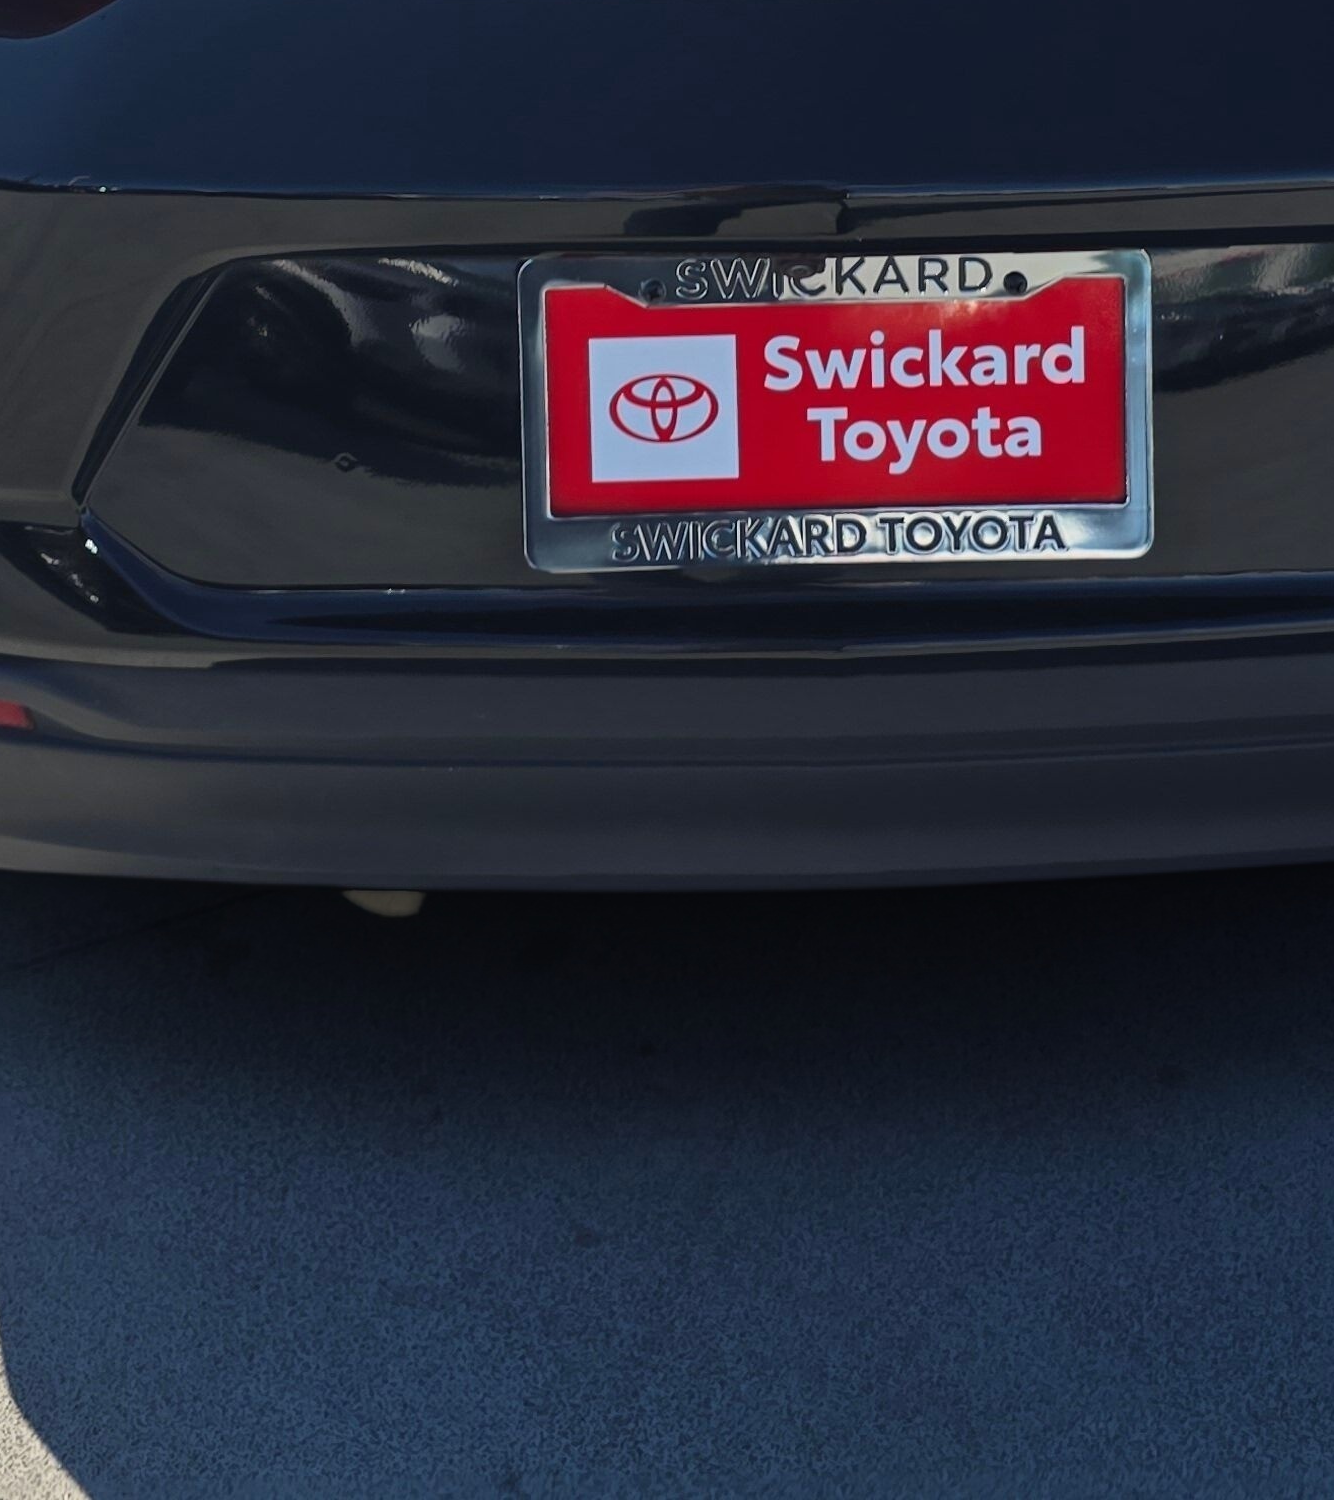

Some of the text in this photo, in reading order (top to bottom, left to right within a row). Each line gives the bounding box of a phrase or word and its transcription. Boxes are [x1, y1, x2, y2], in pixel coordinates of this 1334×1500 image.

[675, 255, 994, 300] SWICKARD
[763, 326, 1086, 391] Swickard
[806, 407, 1043, 475] Toyota
[612, 513, 1067, 562] SWICKARD TOYOTA
